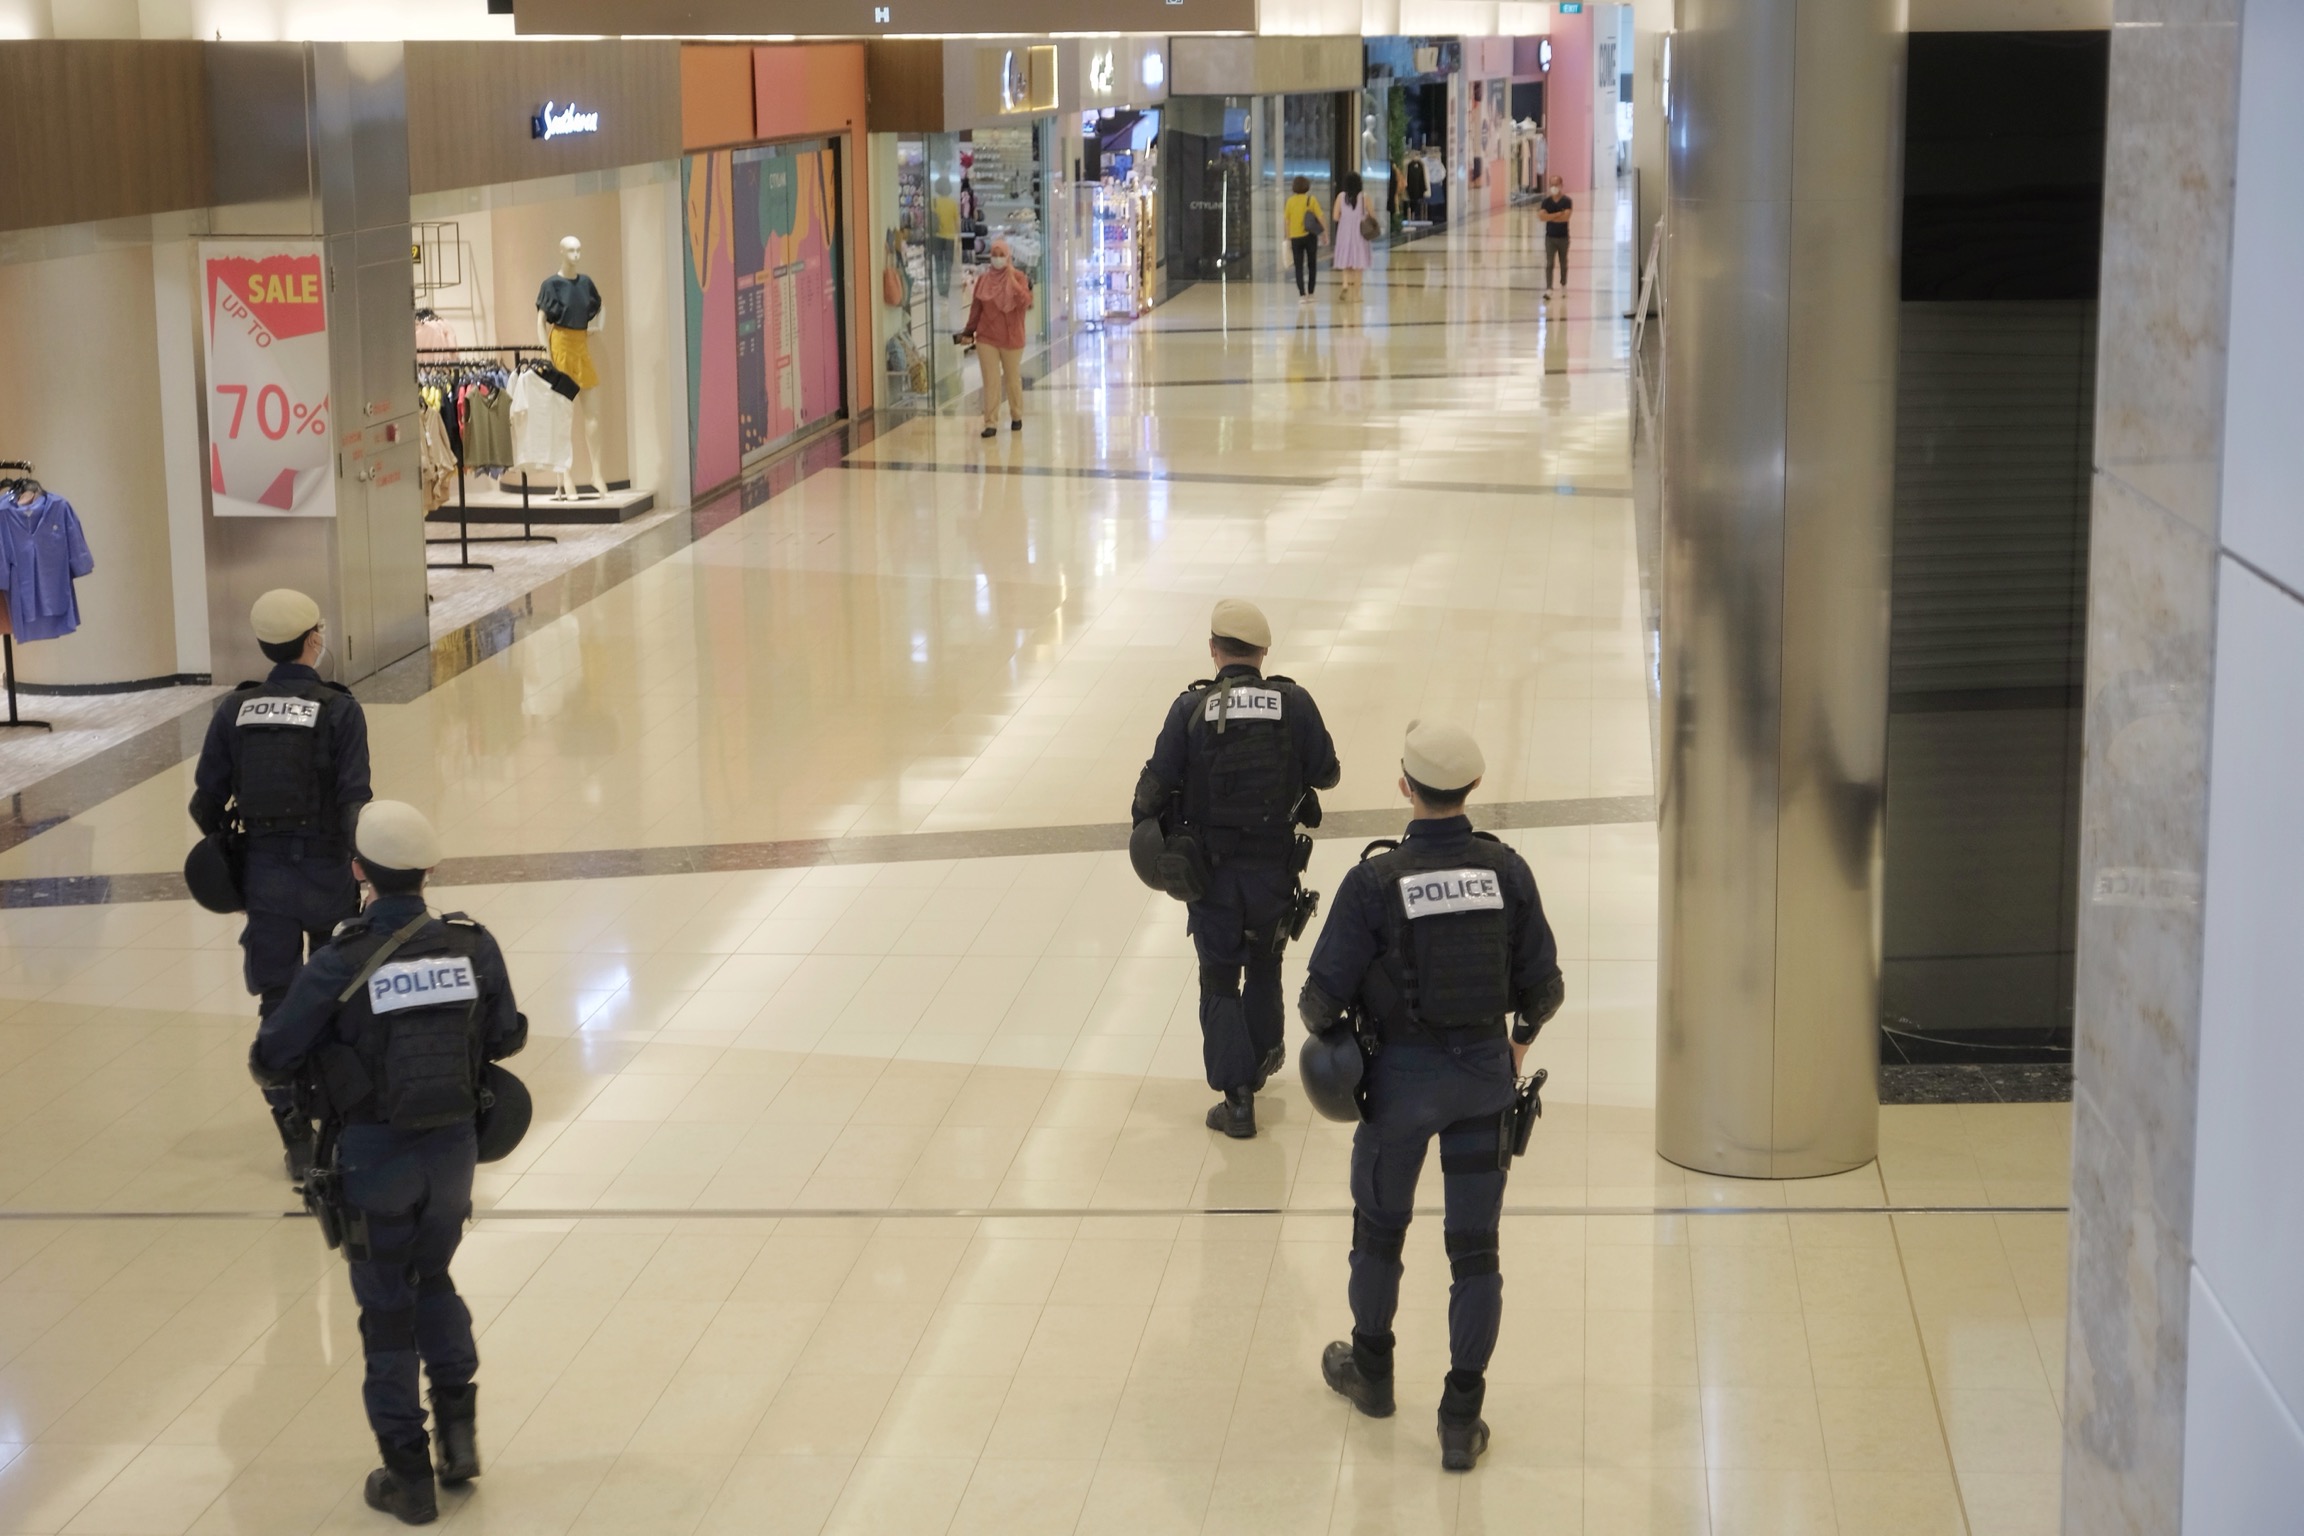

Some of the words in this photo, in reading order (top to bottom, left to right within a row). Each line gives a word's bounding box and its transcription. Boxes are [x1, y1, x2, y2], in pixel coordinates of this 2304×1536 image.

[248, 274, 319, 304] SALE
[222, 294, 248, 320] UP
[247, 319, 272, 348] TO
[216, 383, 326, 441] 70%
[241, 702, 314, 717] POLICE
[1209, 695, 1278, 711] POLICE
[1407, 880, 1497, 905] POLICE
[374, 967, 470, 1000] POLICE
